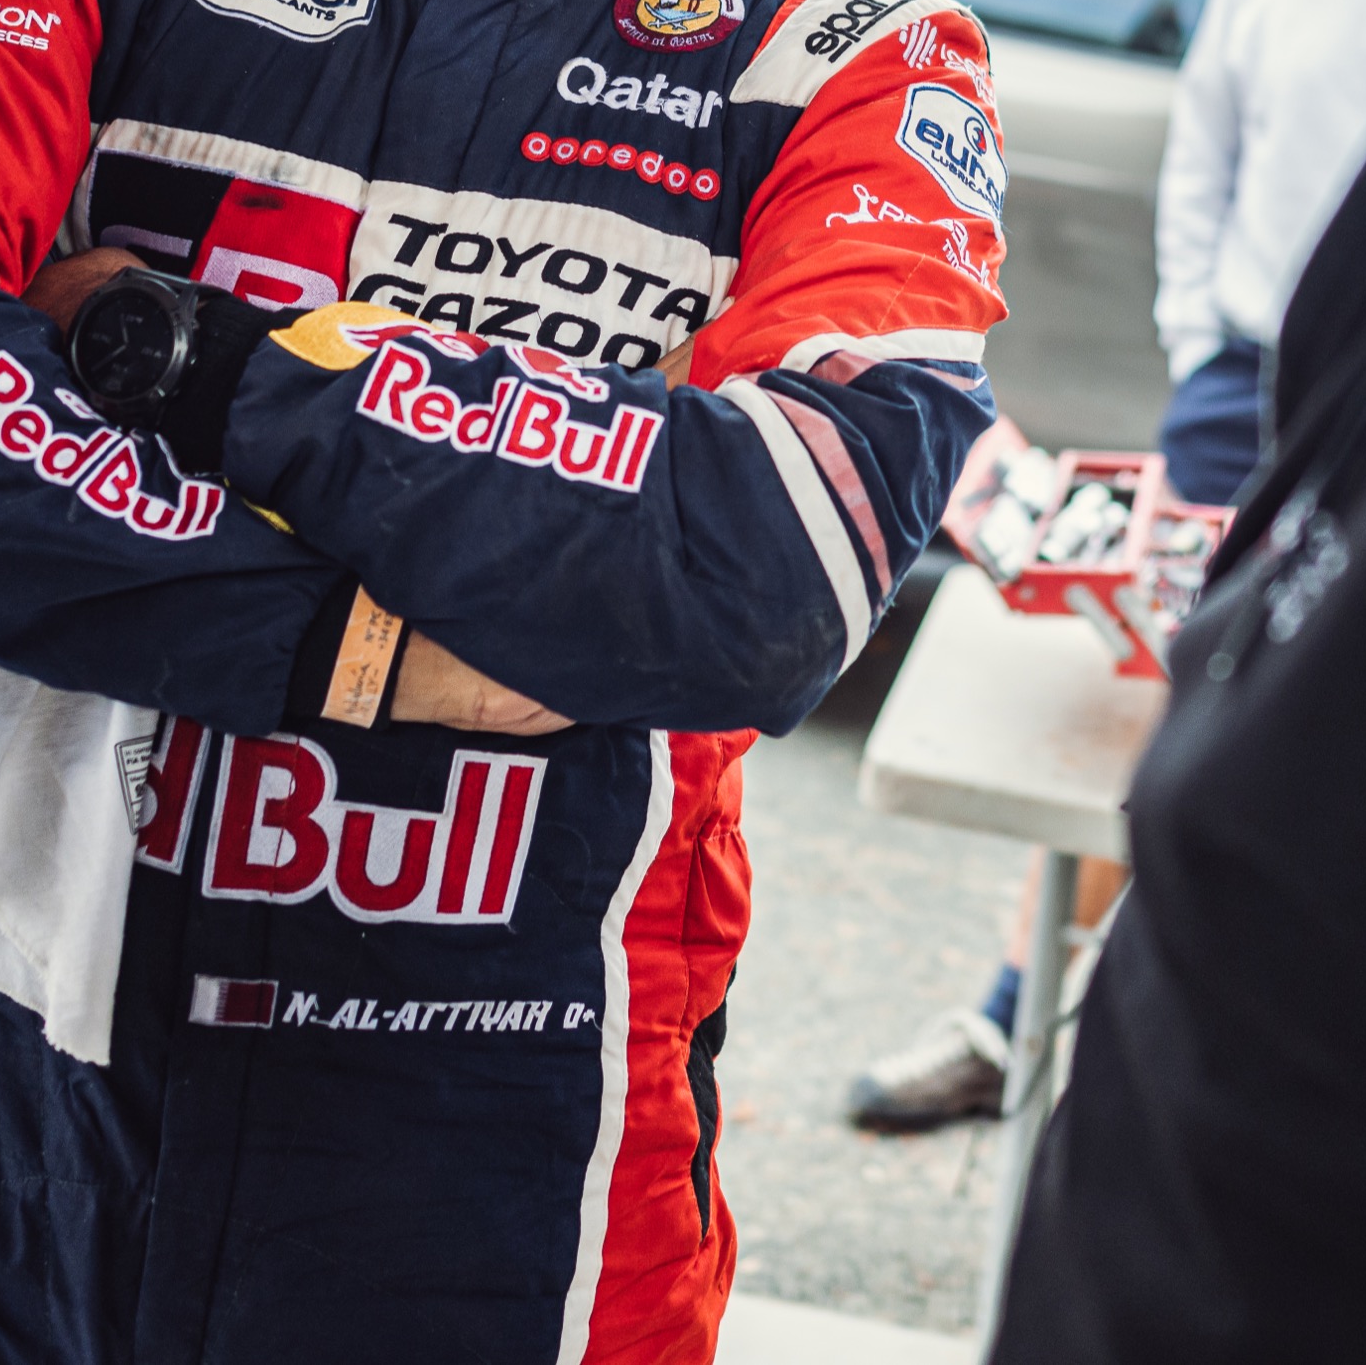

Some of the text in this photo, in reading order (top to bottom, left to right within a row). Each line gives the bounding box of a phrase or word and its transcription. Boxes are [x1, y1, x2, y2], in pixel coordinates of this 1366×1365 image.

[556, 56, 723, 129] Qatar
[526, 136, 715, 195] ooredoo
[350, 273, 662, 369] GAZOO
[388, 213, 711, 333] TOYOTA
[358, 342, 662, 491] Red Bull
[79, 439, 223, 539] Bull
[206, 733, 542, 921] Bull
[329, 998, 553, 1032] AL-ATTIYAH
